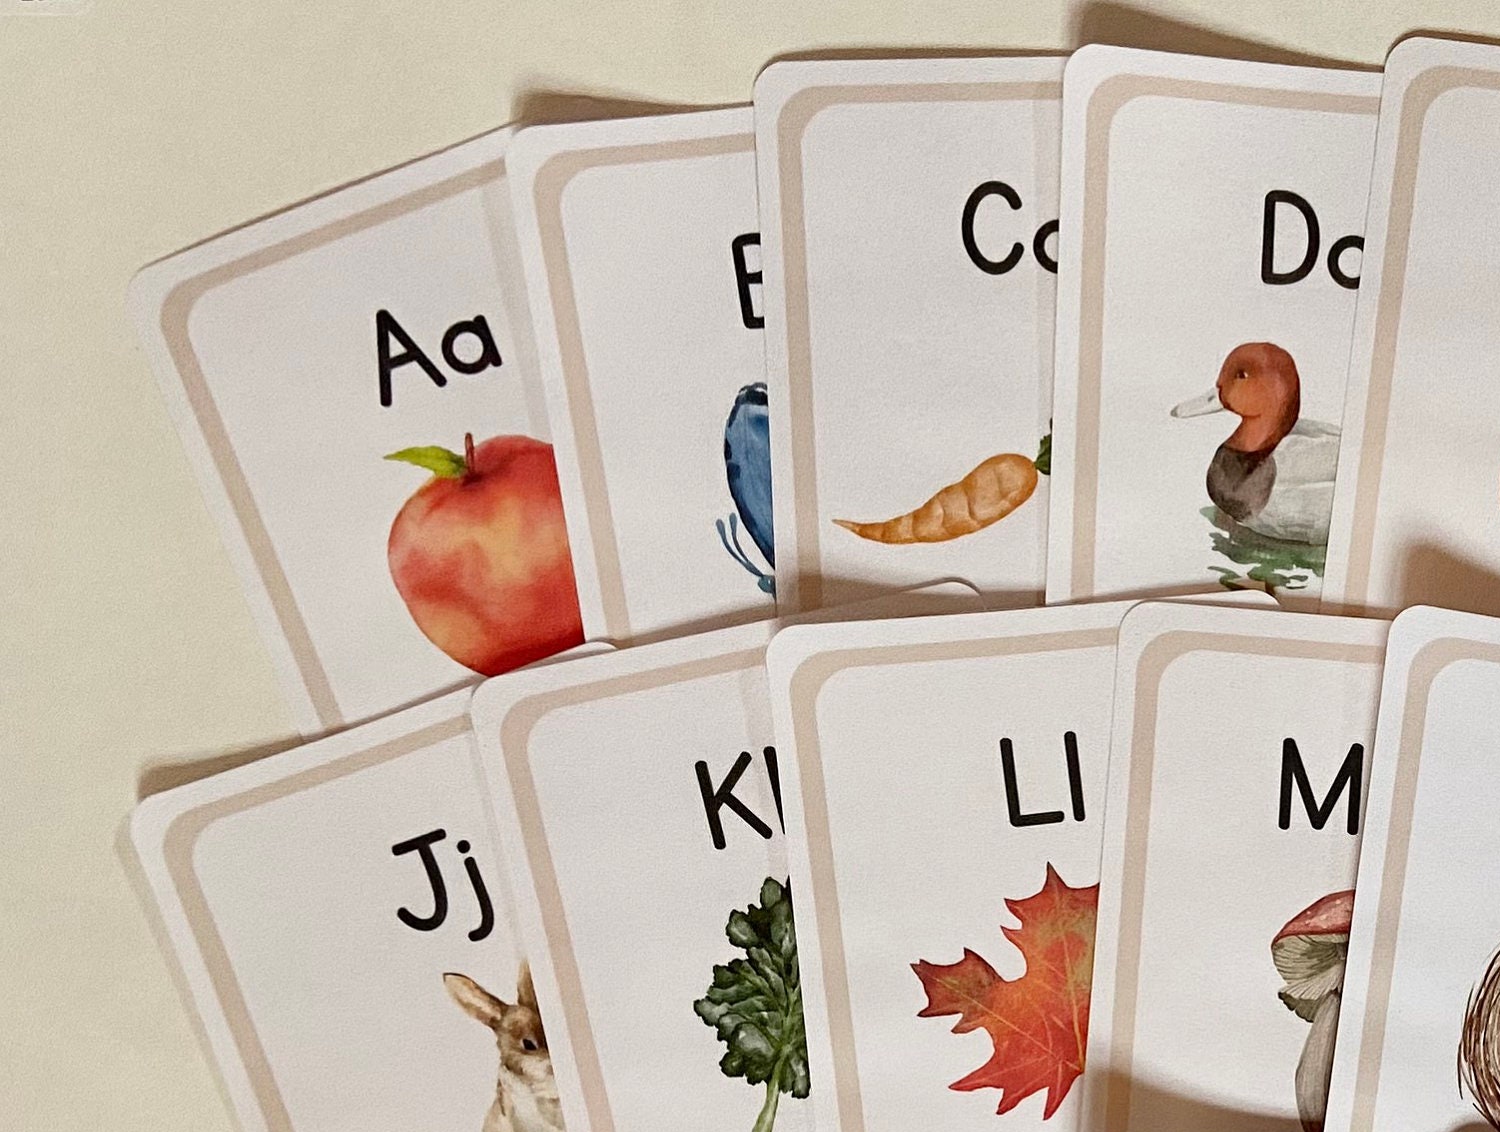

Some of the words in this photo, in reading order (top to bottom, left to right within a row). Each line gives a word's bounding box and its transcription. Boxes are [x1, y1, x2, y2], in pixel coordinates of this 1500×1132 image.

[376, 310, 502, 406] Aa
[1000, 731, 1085, 827] Ll
[1279, 738, 1364, 835] M
[392, 829, 494, 941] Jj
